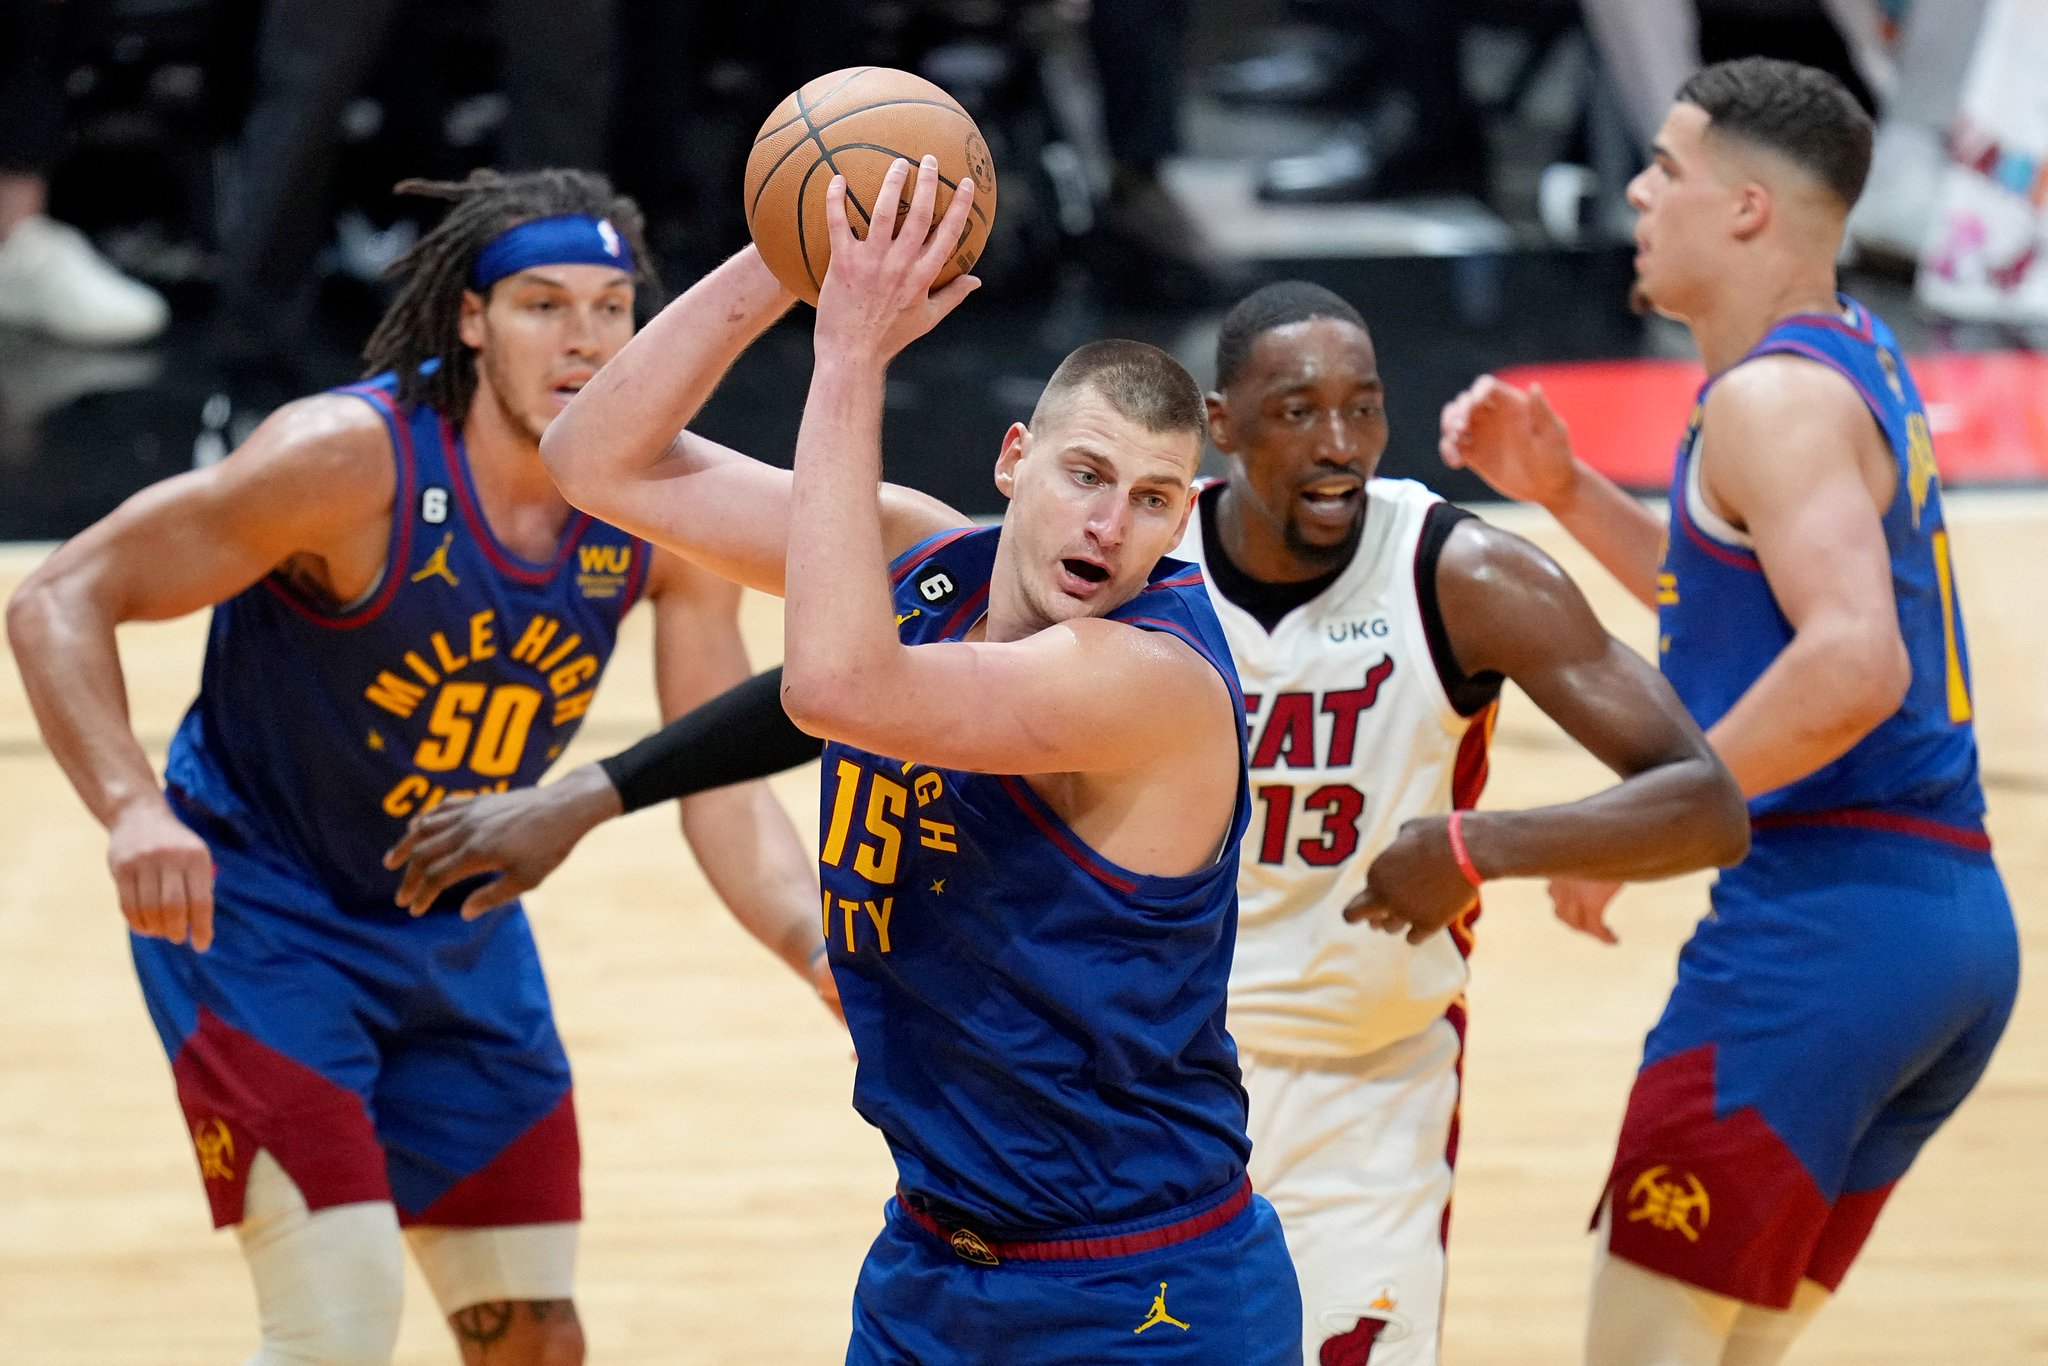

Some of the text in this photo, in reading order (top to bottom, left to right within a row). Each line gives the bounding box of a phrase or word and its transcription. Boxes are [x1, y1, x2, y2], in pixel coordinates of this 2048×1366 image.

[423, 487, 449, 524] 6
[578, 545, 632, 574] WU
[919, 572, 954, 602] 6
[1328, 617, 1390, 643] UKG
[364, 609, 599, 726] MILE HIGH
[413, 681, 544, 777] 50
[1244, 652, 1395, 769] AT
[821, 759, 909, 885] 15
[1257, 783, 1366, 867] 13
[822, 889, 894, 954] ITY
